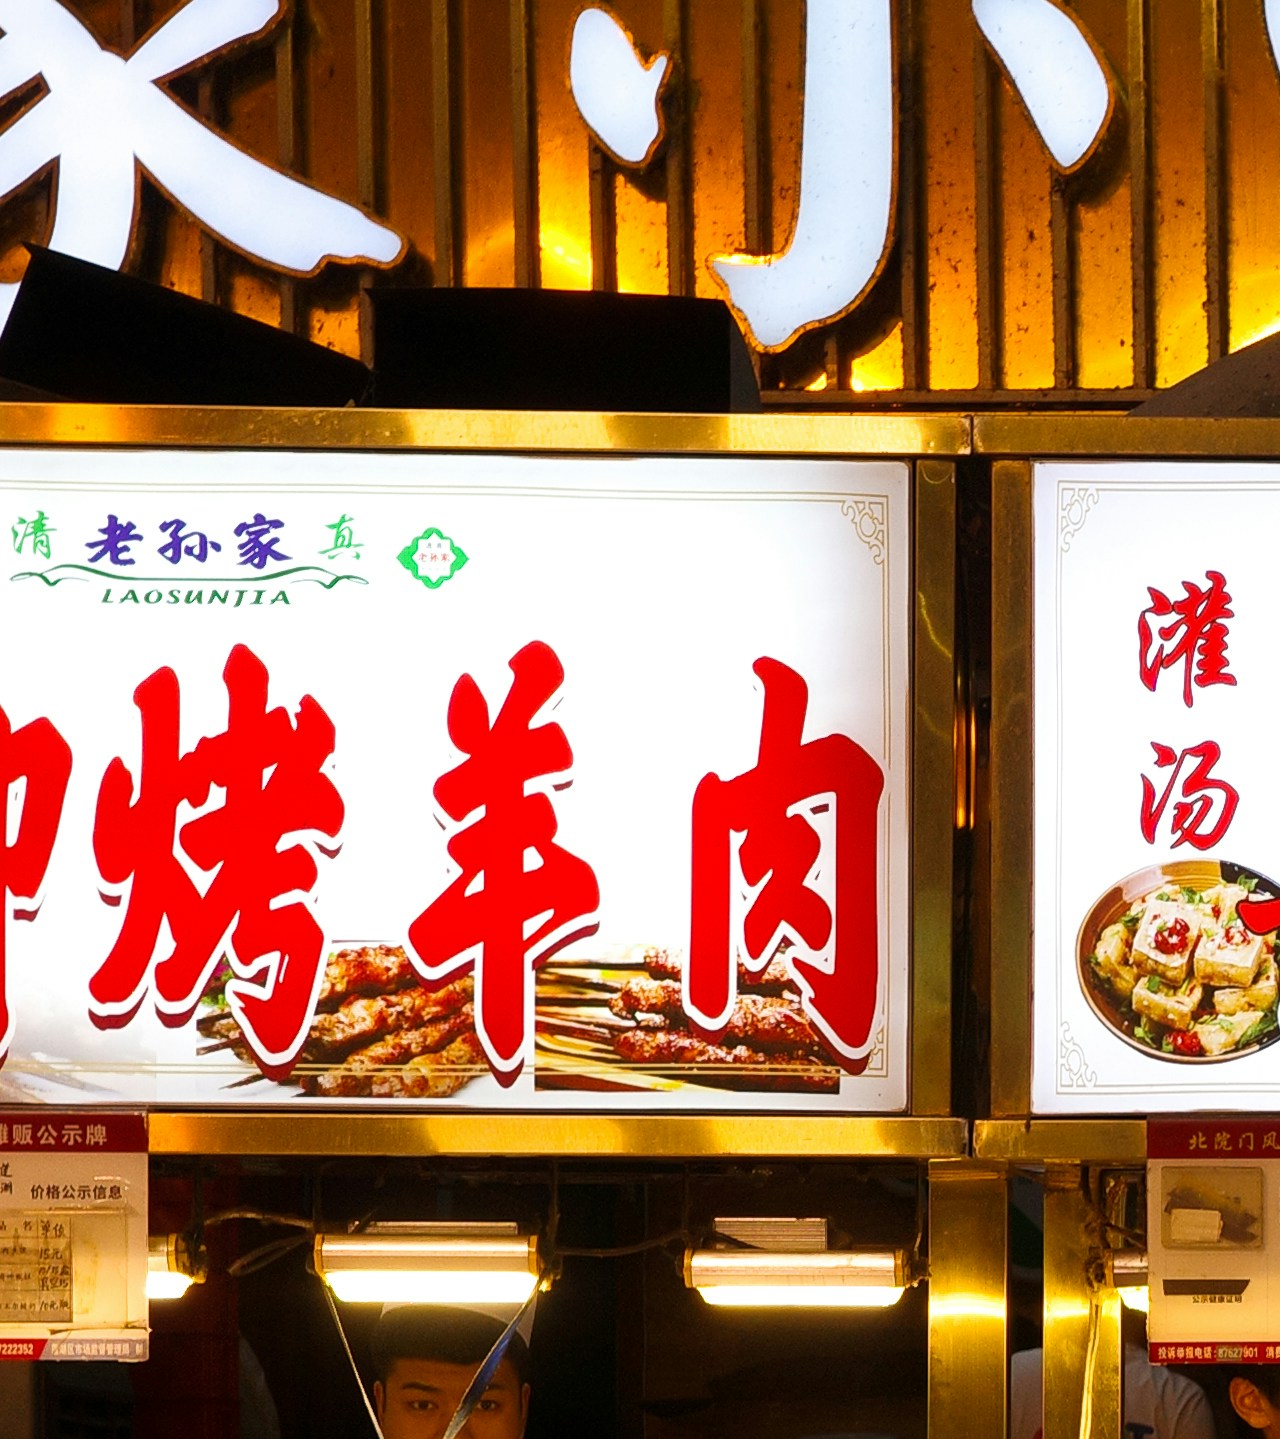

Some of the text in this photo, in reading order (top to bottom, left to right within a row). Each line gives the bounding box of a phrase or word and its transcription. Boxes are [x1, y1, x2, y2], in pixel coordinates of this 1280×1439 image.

[12, 510, 364, 569] 清 老孙家 真
[103, 588, 290, 608] LAOSUNJIA
[1138, 570, 1239, 850] 灌汤
[30, 1184, 123, 1201] 价格公示信息
